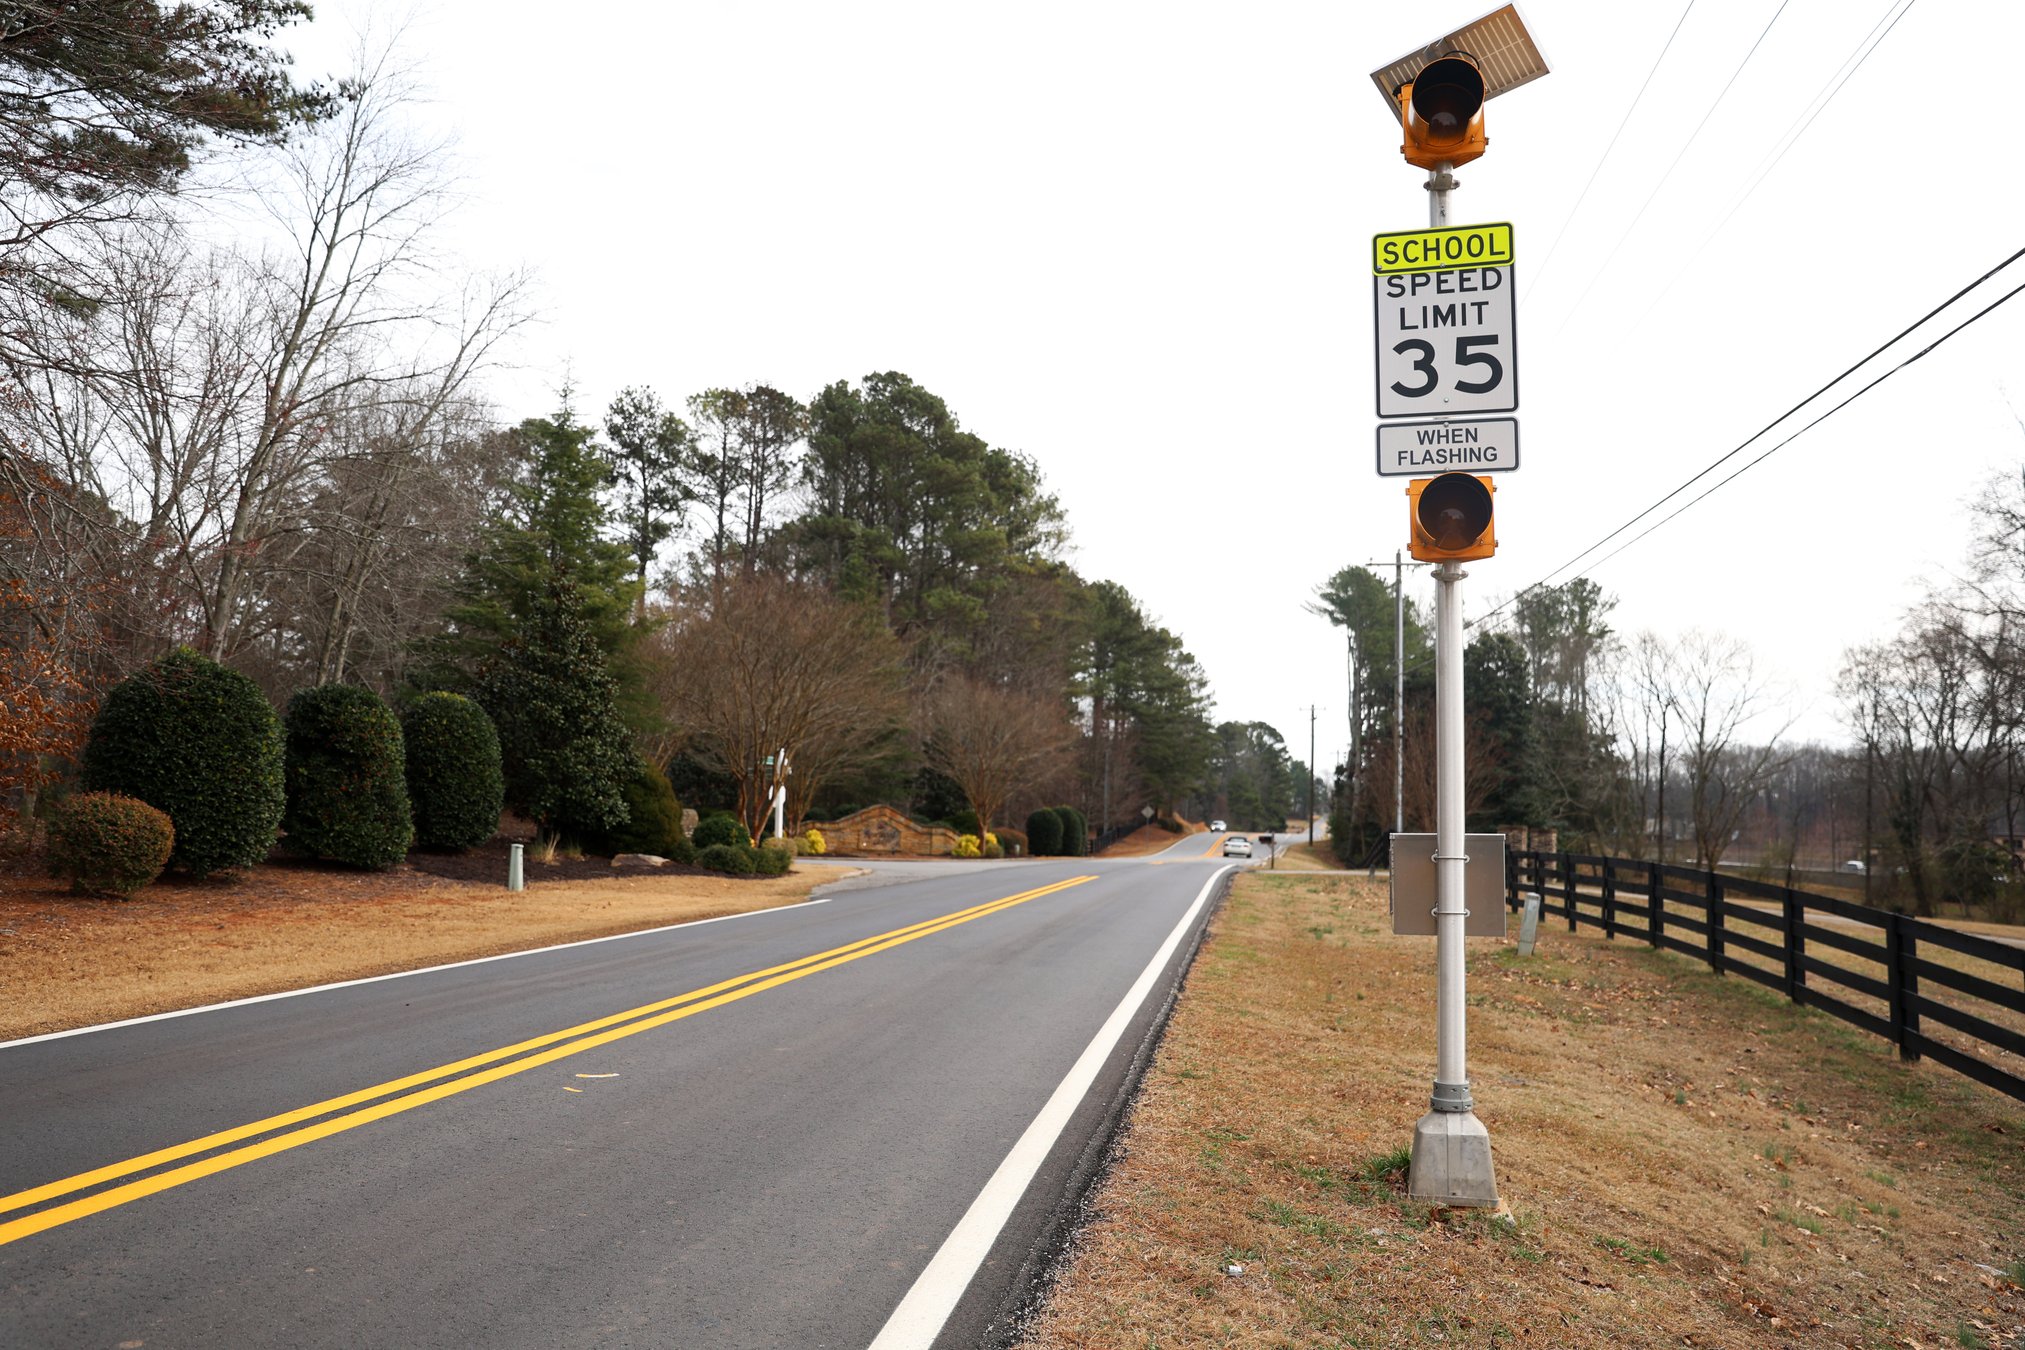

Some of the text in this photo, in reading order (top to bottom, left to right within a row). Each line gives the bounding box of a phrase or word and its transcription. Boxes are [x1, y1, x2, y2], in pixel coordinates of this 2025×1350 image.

[1383, 233, 1505, 264] SCHOOL
[1387, 267, 1502, 298] SPEED
[1400, 301, 1489, 330] LIMIT
[1390, 334, 1503, 398] 35
[1417, 427, 1478, 445] WHEN
[1398, 446, 1498, 466] FLASHING
